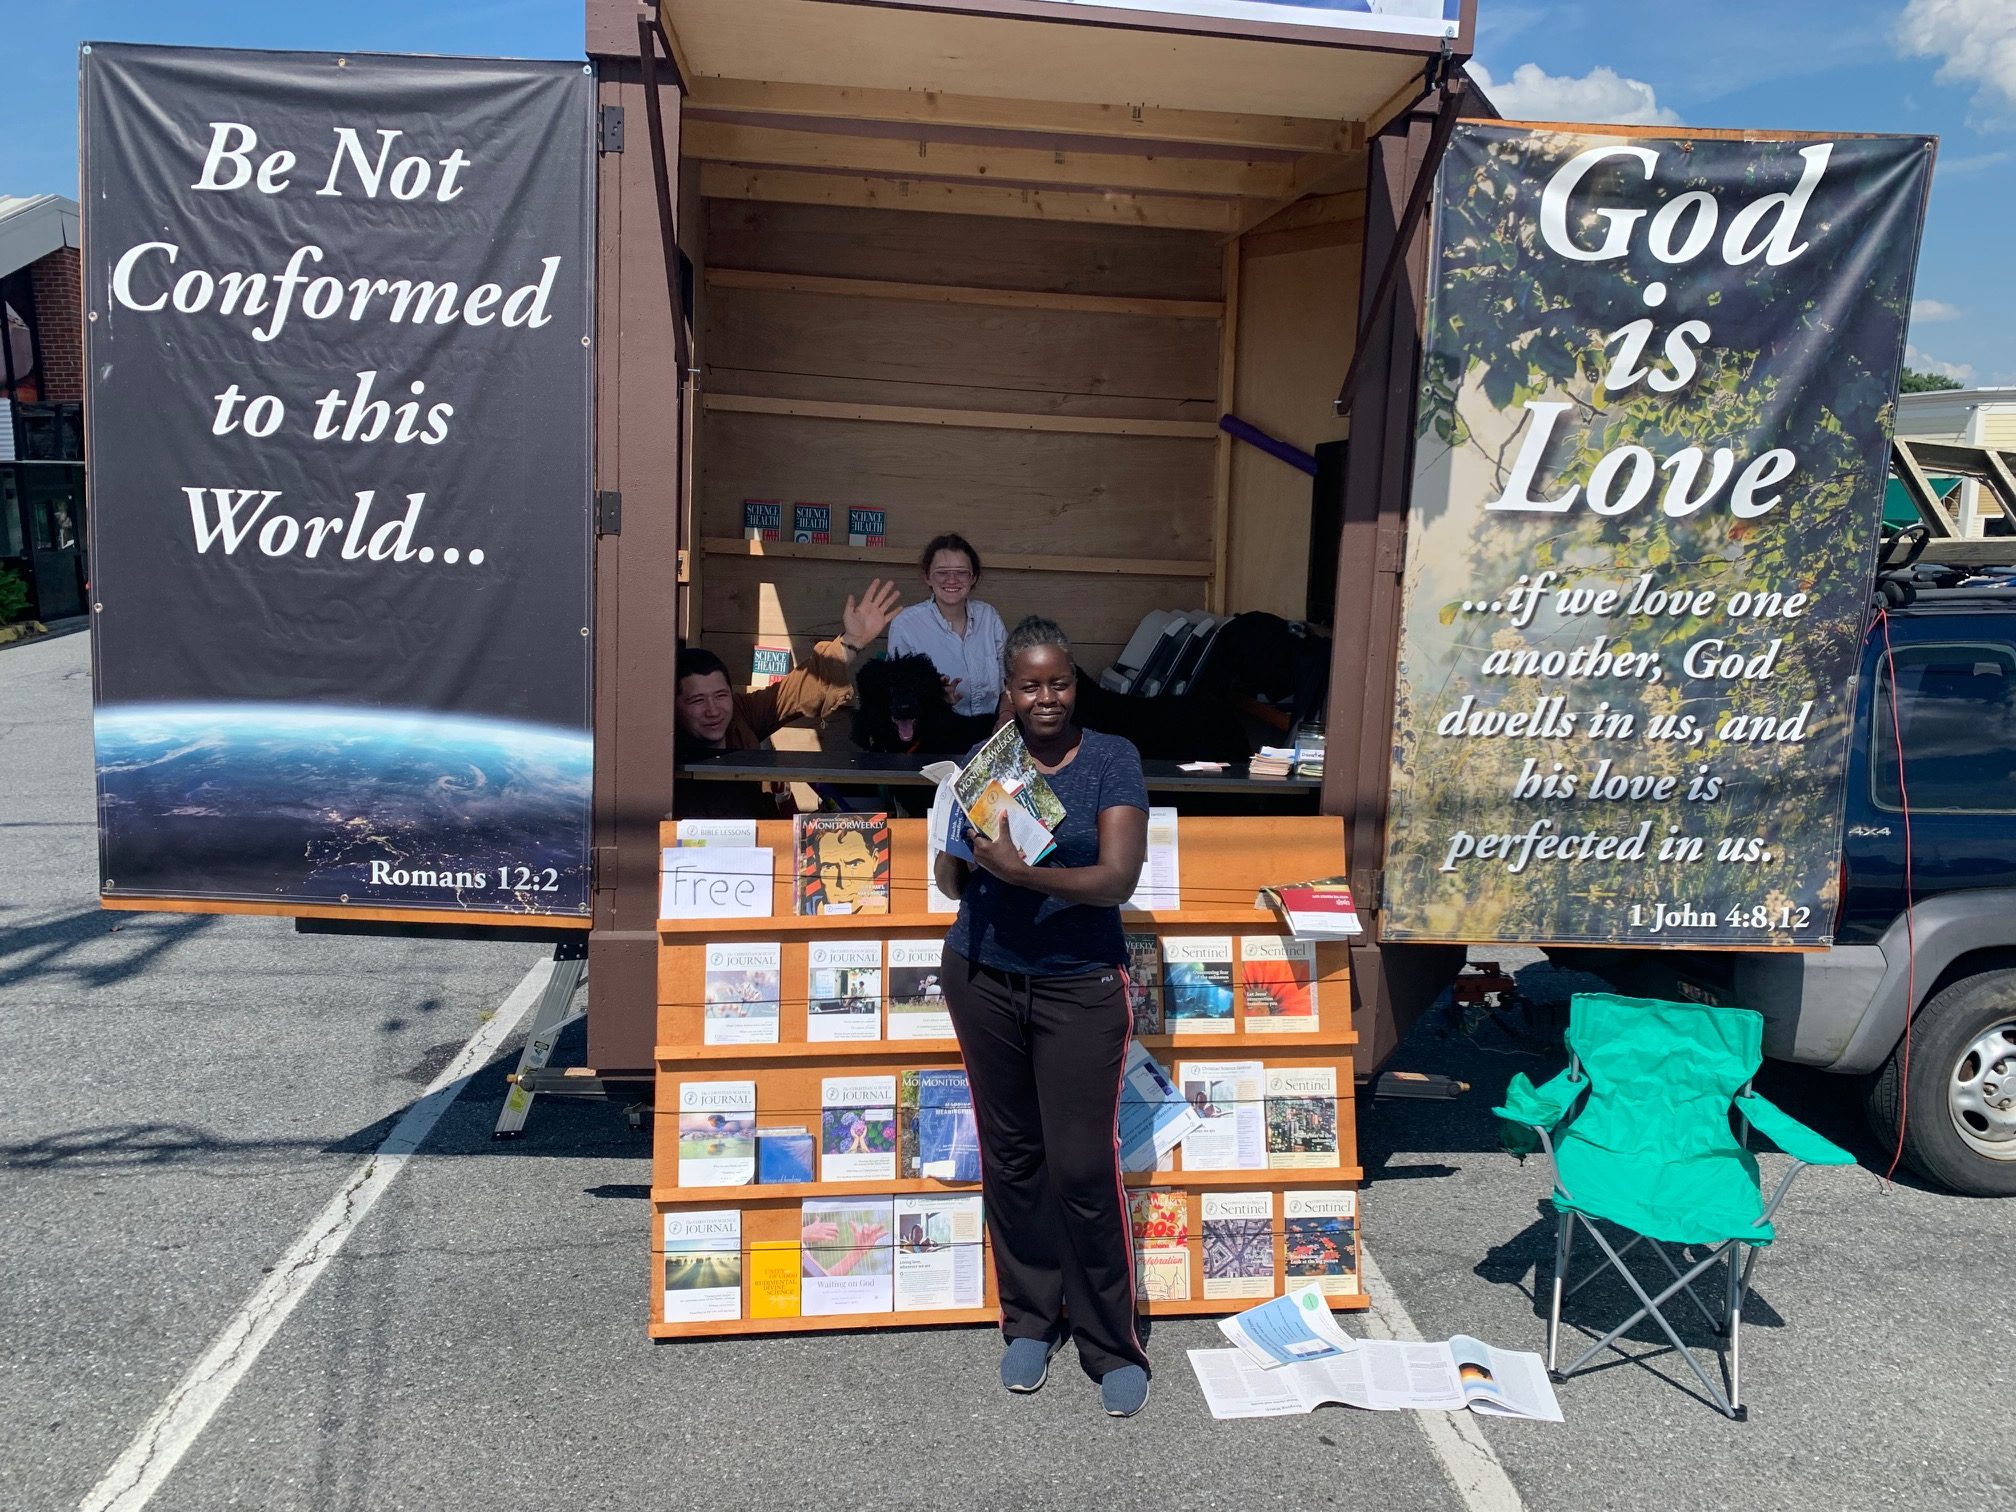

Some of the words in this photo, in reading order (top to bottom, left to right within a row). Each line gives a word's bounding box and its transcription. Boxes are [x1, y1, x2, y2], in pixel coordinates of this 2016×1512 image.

[191, 122, 296, 196] Be
[316, 126, 471, 202] Not
[1540, 142, 1835, 267] God
[112, 242, 561, 342] Conformed
[1604, 281, 1711, 393] is
[211, 384, 284, 438] to
[313, 370, 453, 445] this
[1485, 400, 1797, 519] Love
[747, 504, 779, 515] SCIENCE
[797, 508, 828, 519] SCIENCE
[750, 515, 779, 526] HEALTH
[851, 511, 883, 522] SCIENCE
[182, 486, 485, 566] World...
[799, 518, 828, 529] HEALTH
[854, 521, 883, 532] HEALTH
[1461, 571, 1557, 627] ...if
[1556, 585, 1617, 617] we
[1627, 573, 1716, 618] love
[1727, 589, 1808, 619] one
[755, 651, 787, 662] SCIENCE
[1481, 634, 1664, 684] another,
[1682, 638, 1782, 681] God
[757, 661, 786, 672] HEALTH
[1437, 695, 1578, 740] dwells
[1589, 701, 1634, 742] in
[1648, 713, 1704, 747] us,
[1719, 701, 1813, 743] and
[1512, 757, 1579, 801] his
[1589, 758, 1677, 802] love
[1688, 764, 1726, 802] is
[1439, 819, 1652, 873] perfected
[1657, 826, 1703, 863] in
[1715, 834, 1775, 864] us.
[369, 860, 487, 889] Romans
[498, 866, 560, 892] 12:2
[674, 865, 755, 907] Free
[1630, 903, 1643, 927] 1
[1651, 903, 1717, 929] John
[1724, 904, 1811, 933] 4:8,12
[1182, 945, 1228, 958] Sentinel
[1260, 944, 1306, 956] Sentinel
[727, 957, 776, 966] JOURNAL
[830, 954, 879, 963] JOURNAL
[1285, 1078, 1330, 1091] Sentinel
[701, 1095, 752, 1106] JOURNAL
[842, 1090, 892, 1101] JOURNAL
[1220, 1201, 1268, 1215] Sentinel
[1305, 1200, 1351, 1213] Sentinel
[686, 1223, 737, 1234] JOURNAL
[1133, 1221, 1176, 1238] 020s
[817, 1279, 846, 1288] Waiting
[859, 1279, 875, 1287] God
